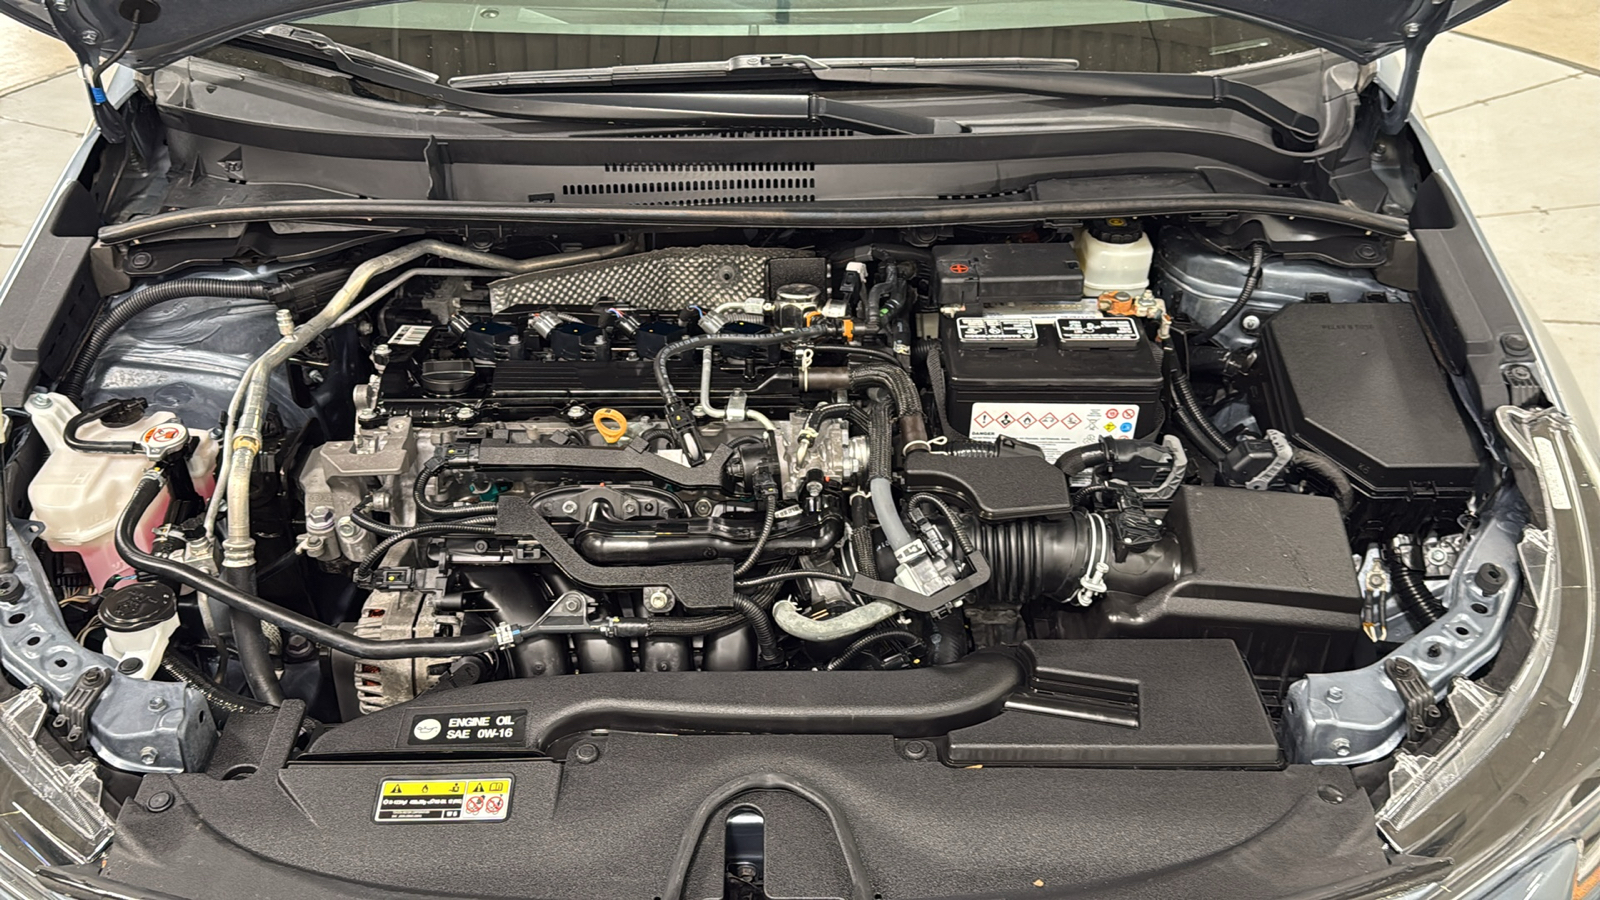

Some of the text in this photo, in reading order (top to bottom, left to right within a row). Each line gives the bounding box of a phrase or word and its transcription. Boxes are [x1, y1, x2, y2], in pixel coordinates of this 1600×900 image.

[448, 715, 515, 727] ENGINE OIL
[446, 728, 513, 739] SAE 0W-16
